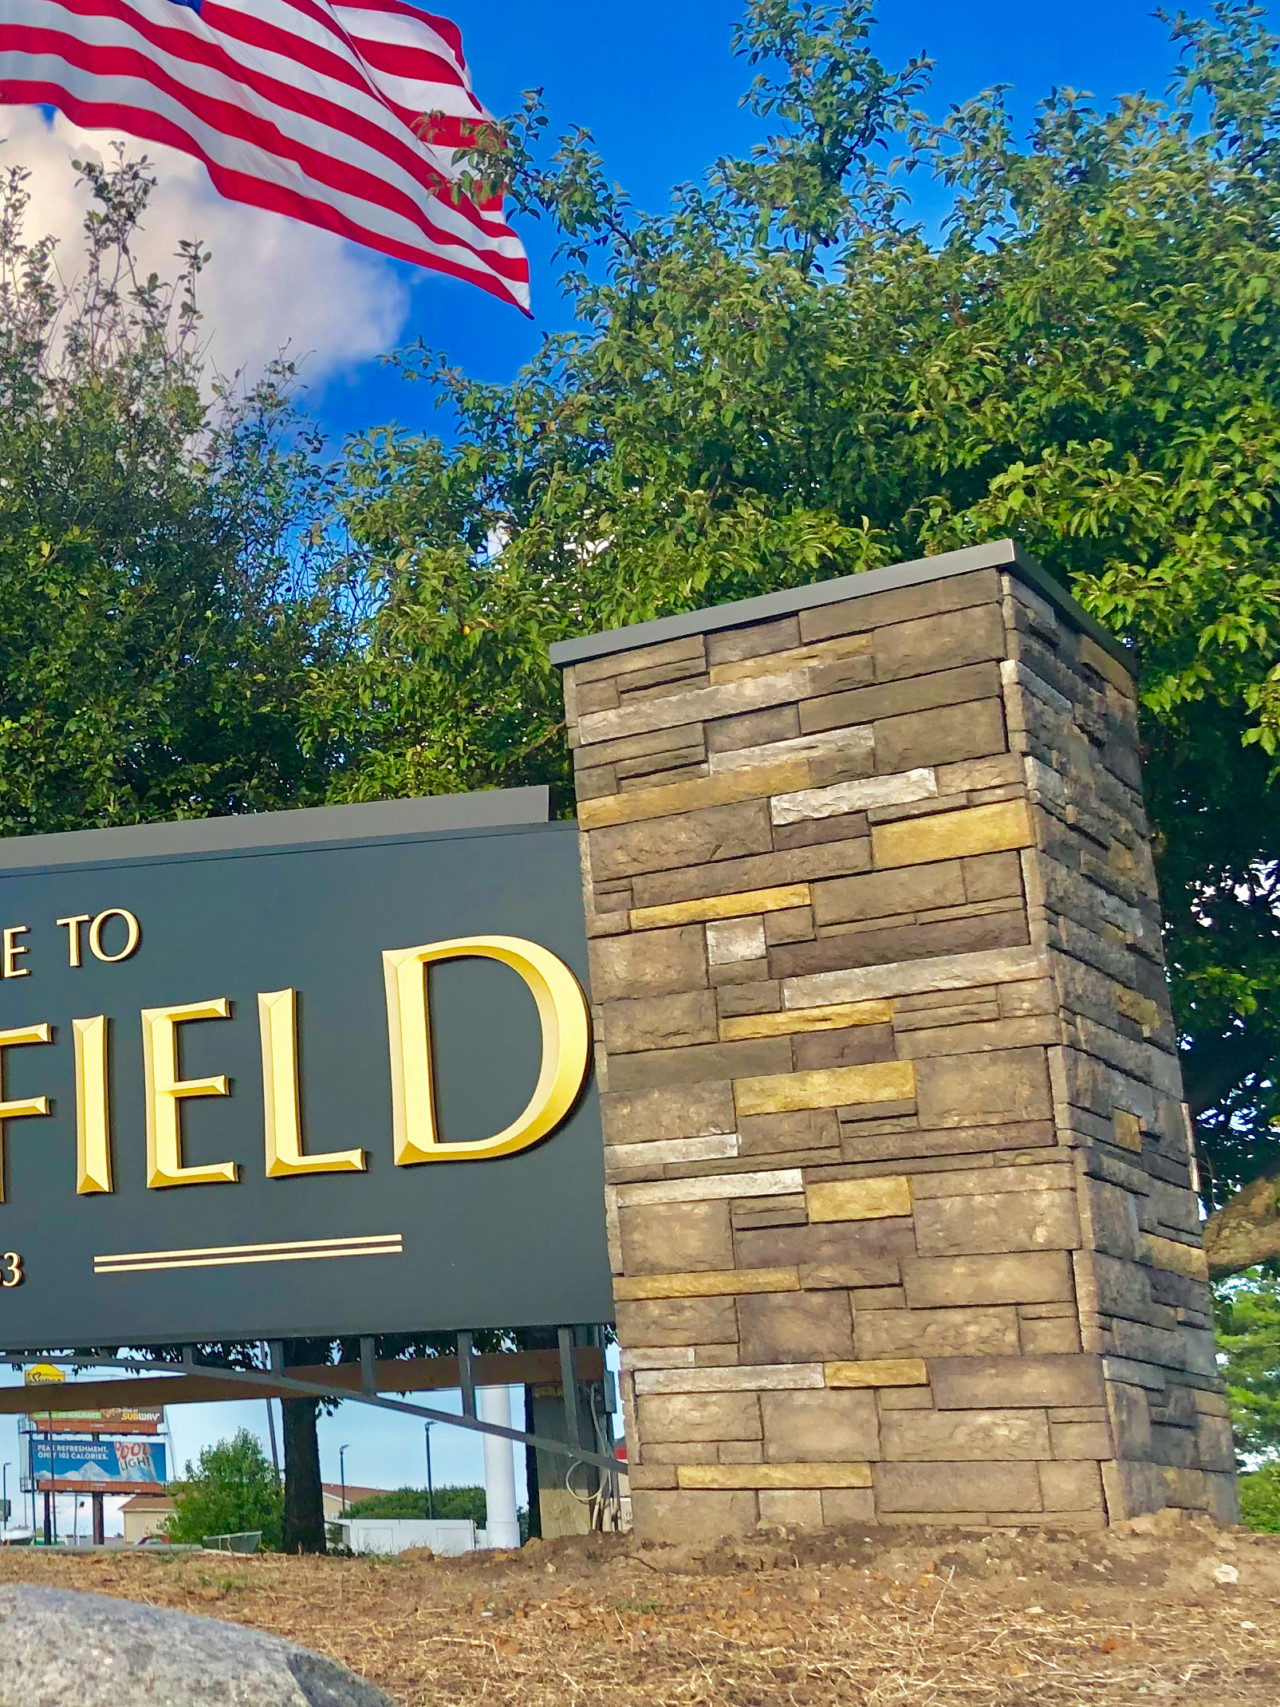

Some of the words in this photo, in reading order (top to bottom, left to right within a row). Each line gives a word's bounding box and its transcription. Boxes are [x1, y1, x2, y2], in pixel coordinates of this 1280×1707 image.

[55, 907, 141, 968] TO
[121, 1412, 160, 1421] SUBWAY
[71, 1452, 109, 1460] CALORIES.
[120, 1456, 151, 1472] LIGHT
